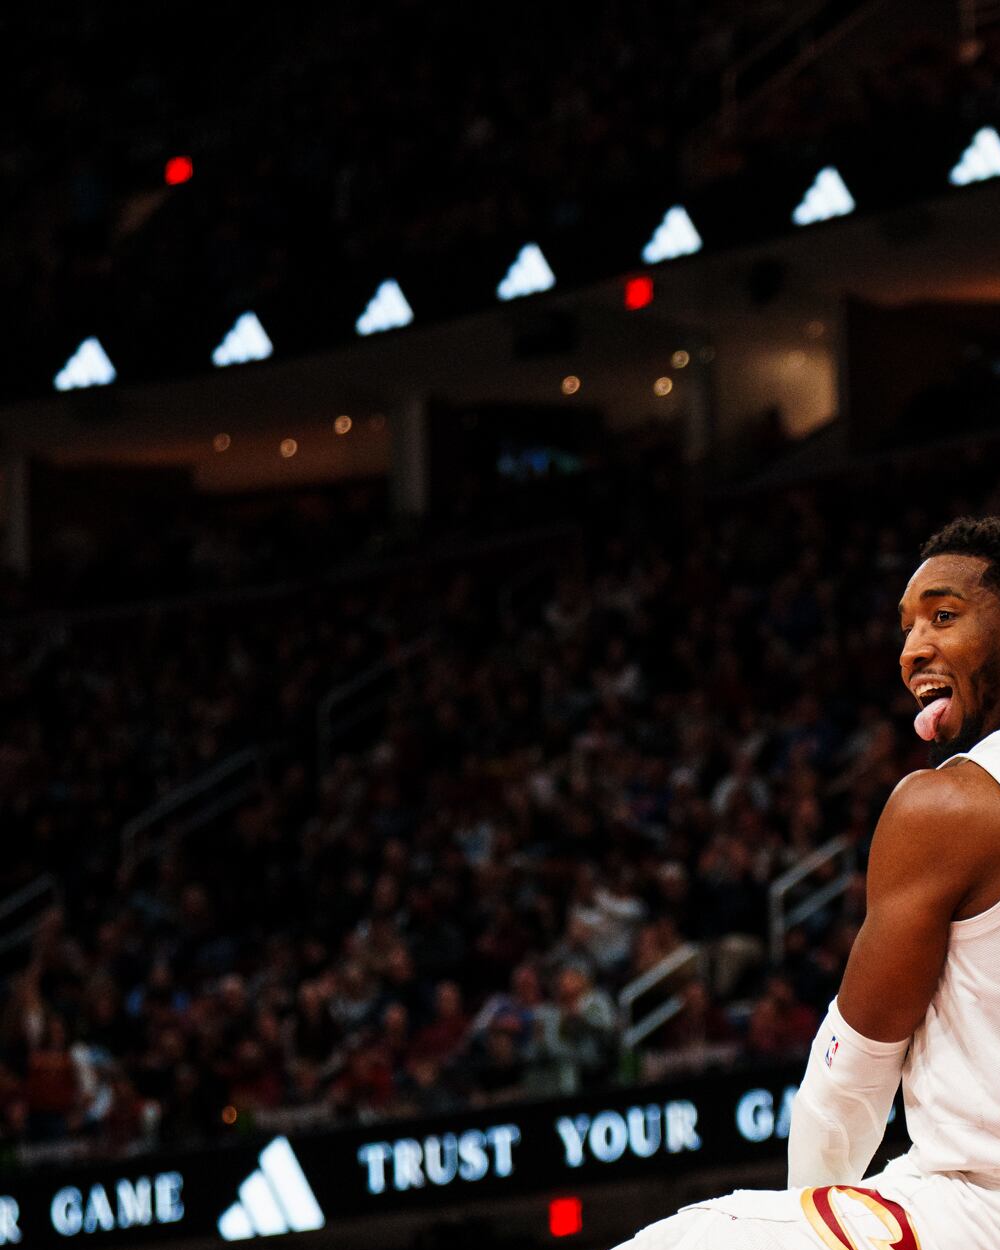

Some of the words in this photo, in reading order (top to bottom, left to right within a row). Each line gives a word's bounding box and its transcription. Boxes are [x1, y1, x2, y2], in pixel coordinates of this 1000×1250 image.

[358, 1124, 521, 1195] TRUST
[556, 1101, 702, 1168] YOUR
[52, 1172, 185, 1237] GAME
